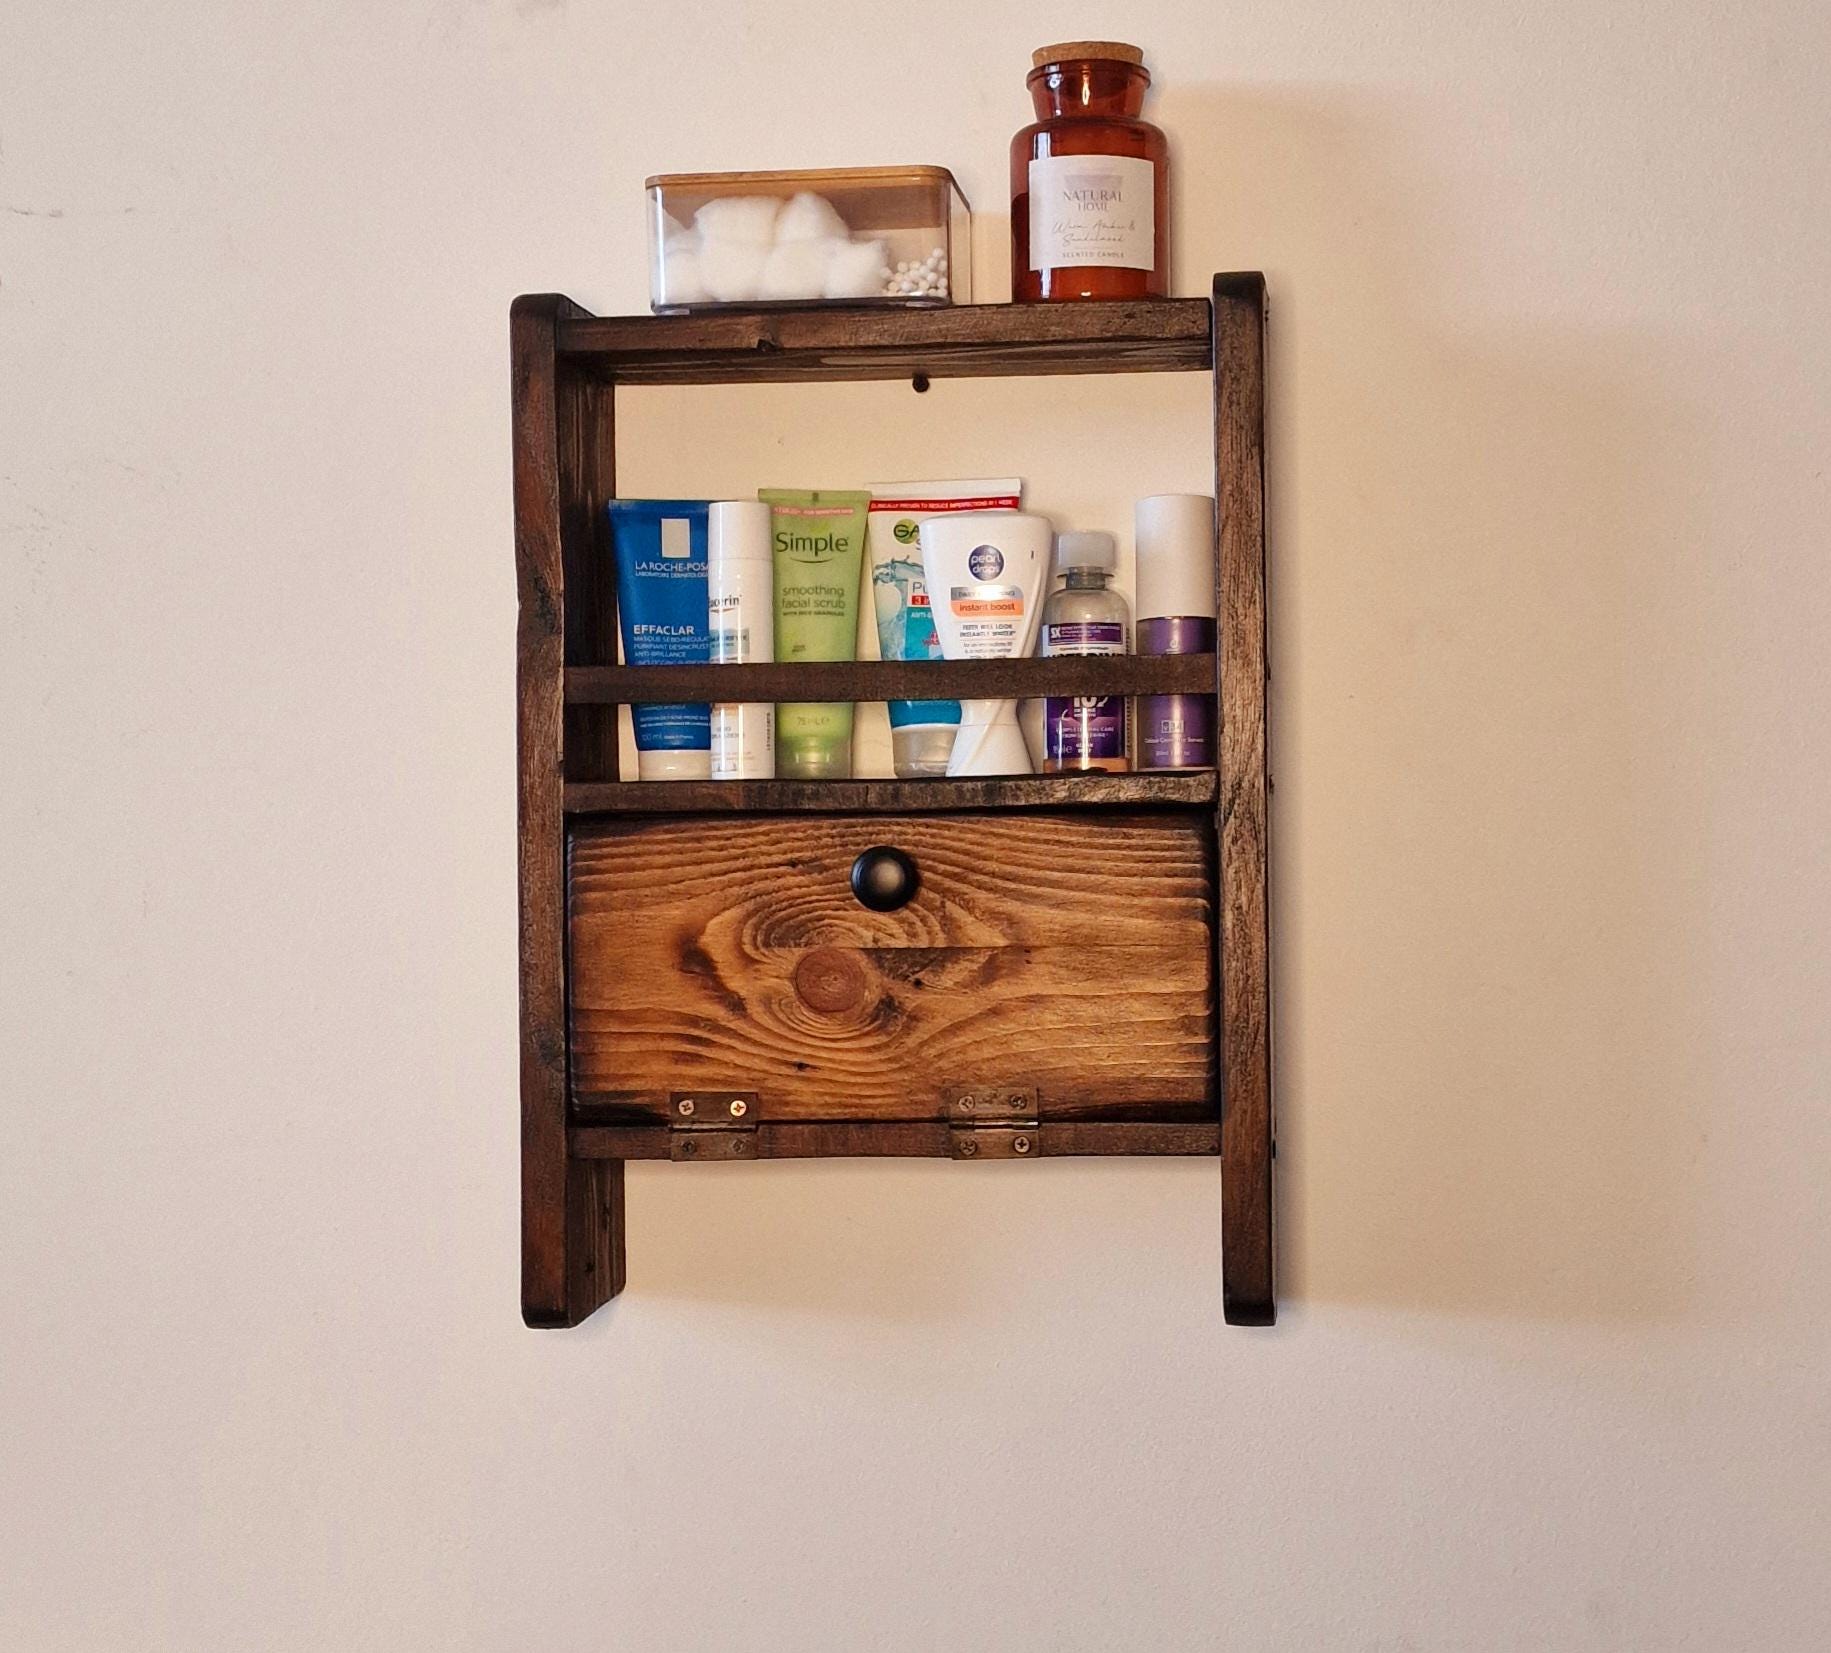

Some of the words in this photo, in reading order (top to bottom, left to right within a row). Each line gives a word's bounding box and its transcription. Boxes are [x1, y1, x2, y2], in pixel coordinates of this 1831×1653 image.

[1063, 189, 1122, 202] NATURAL
[893, 524, 920, 538] GA
[775, 531, 849, 557] Simple
[971, 553, 1001, 566] pearl
[635, 561, 648, 571] LA
[971, 565, 1000, 575] drops
[782, 585, 845, 598] smoothing
[782, 597, 811, 609] facial
[814, 597, 846, 609] scrub
[914, 596, 921, 604] 3
[959, 602, 989, 611] instant
[990, 602, 1016, 611] boost
[633, 624, 695, 635] EFFACLAR
